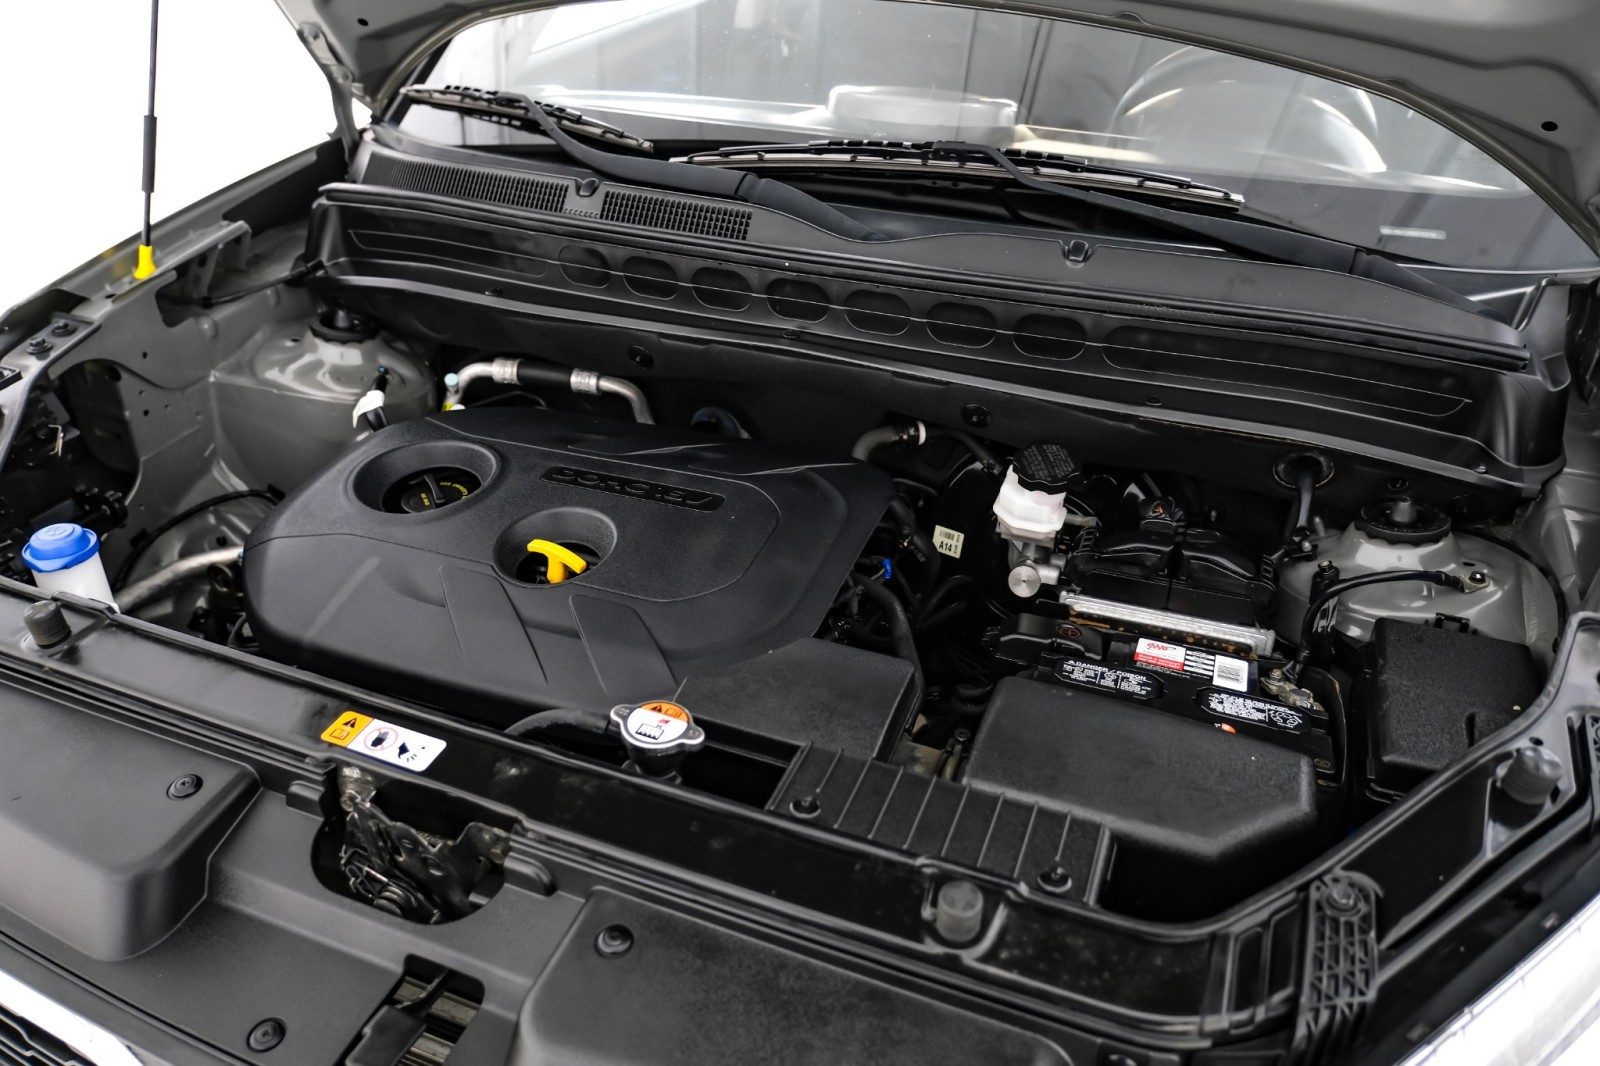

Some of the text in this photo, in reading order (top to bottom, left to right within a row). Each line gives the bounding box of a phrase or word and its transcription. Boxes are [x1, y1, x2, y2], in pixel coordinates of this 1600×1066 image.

[938, 540, 953, 553] A14
[1076, 661, 1109, 673] DANGER
[1116, 670, 1147, 681] POISON
